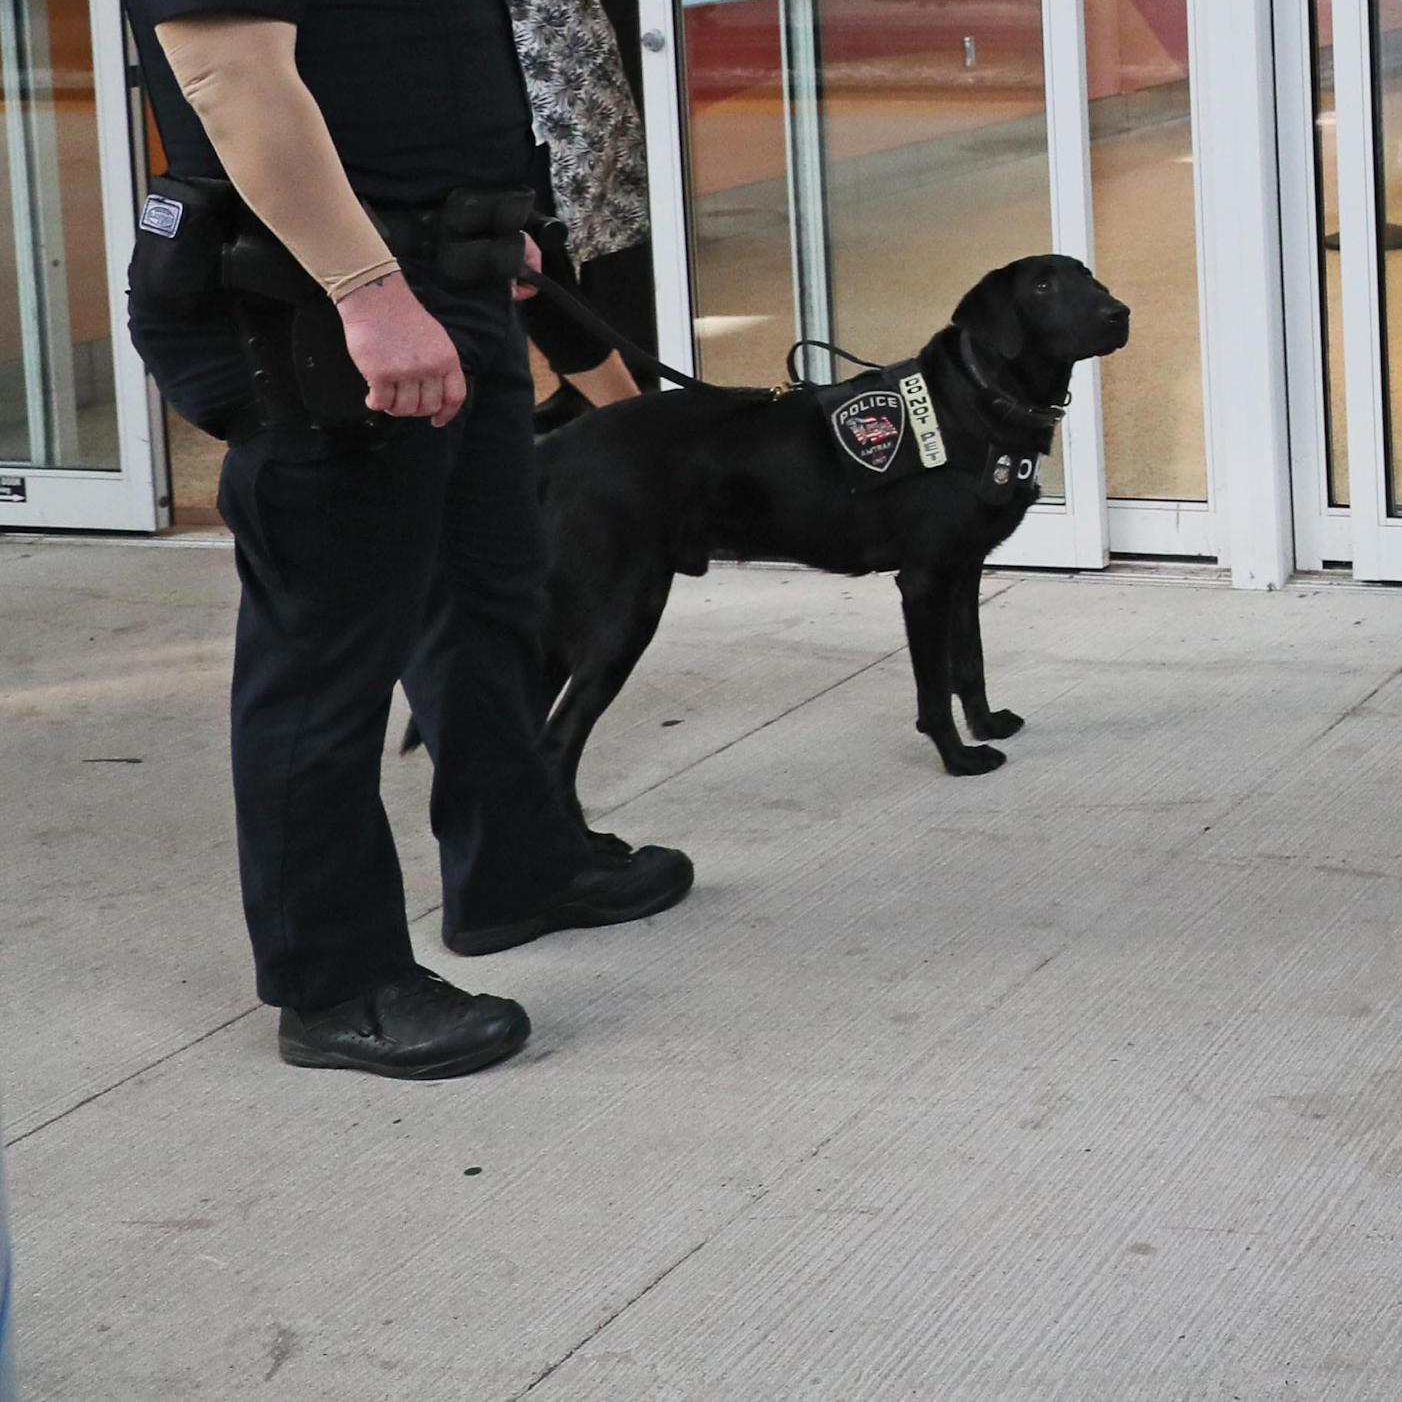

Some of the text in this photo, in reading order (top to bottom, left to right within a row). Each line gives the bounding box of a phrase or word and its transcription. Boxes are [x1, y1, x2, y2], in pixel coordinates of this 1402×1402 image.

[840, 396, 898, 425] POLICE
[904, 378, 940, 461] DO NOT PET
[861, 441, 892, 457] AMTRAK
